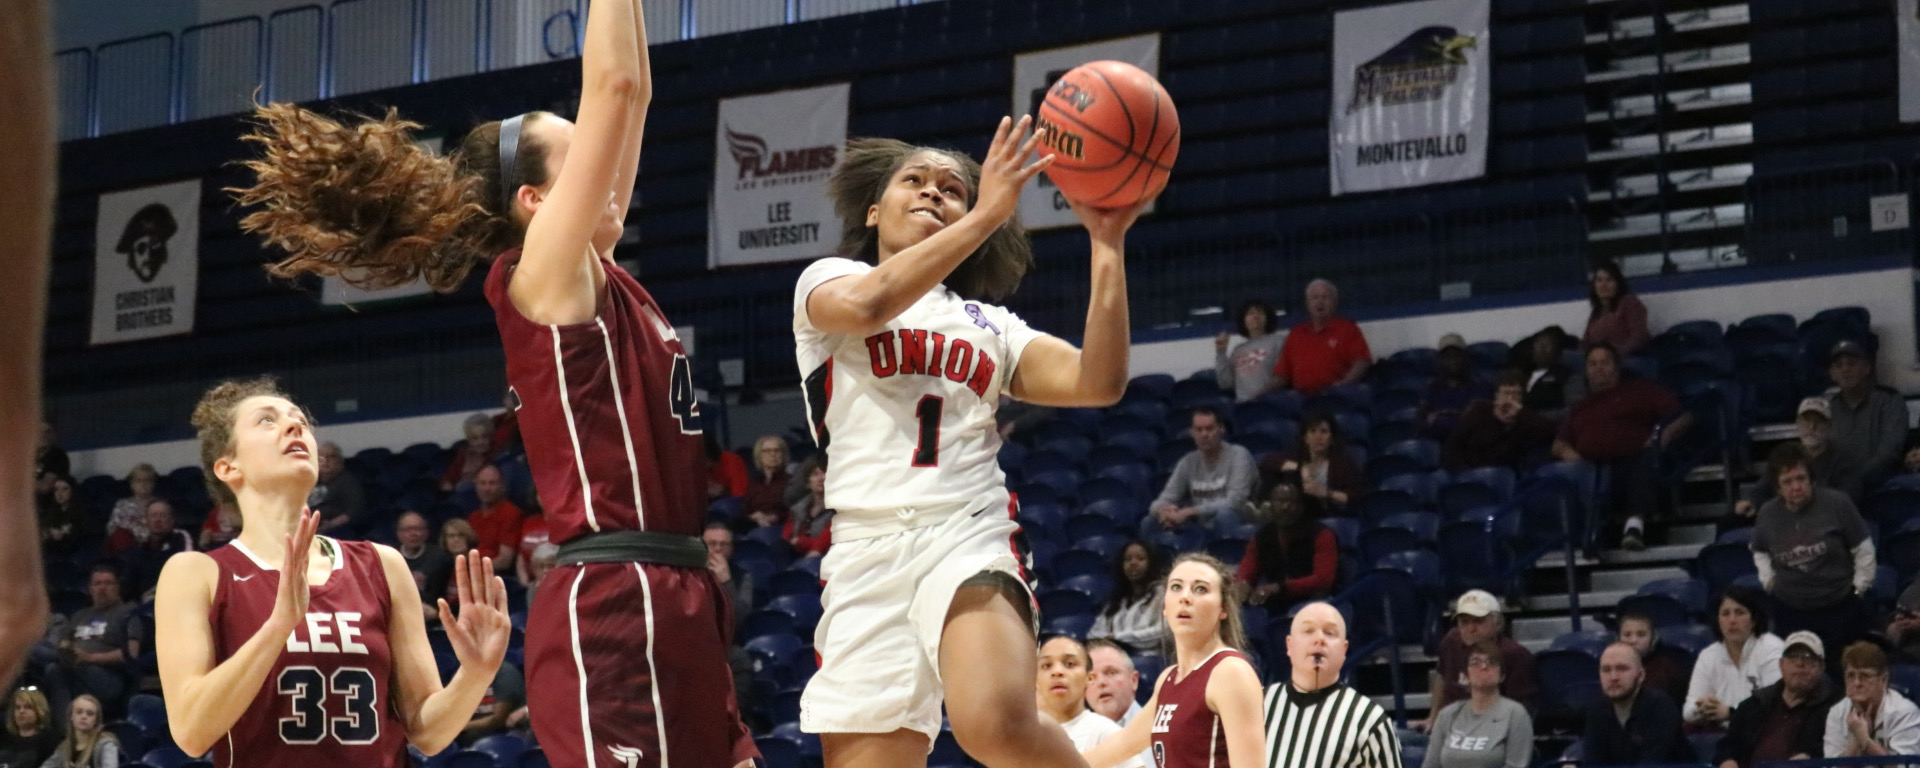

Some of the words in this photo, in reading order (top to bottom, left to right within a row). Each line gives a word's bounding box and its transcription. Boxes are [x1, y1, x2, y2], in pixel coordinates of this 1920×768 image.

[727, 129, 838, 181] FLAMES
[1356, 133, 1467, 167] MONTEVALLO
[767, 202, 792, 223] LEE
[738, 222, 821, 250] UNIVERSITY
[115, 285, 176, 312] CHRISTIAN
[115, 306, 174, 332] BROTHERS
[864, 328, 996, 400] UNION
[910, 393, 945, 468] 1
[286, 611, 370, 655] LEE
[276, 665, 380, 746] 33
[1151, 703, 1179, 734] LEE
[1449, 730, 1489, 751] LEE
